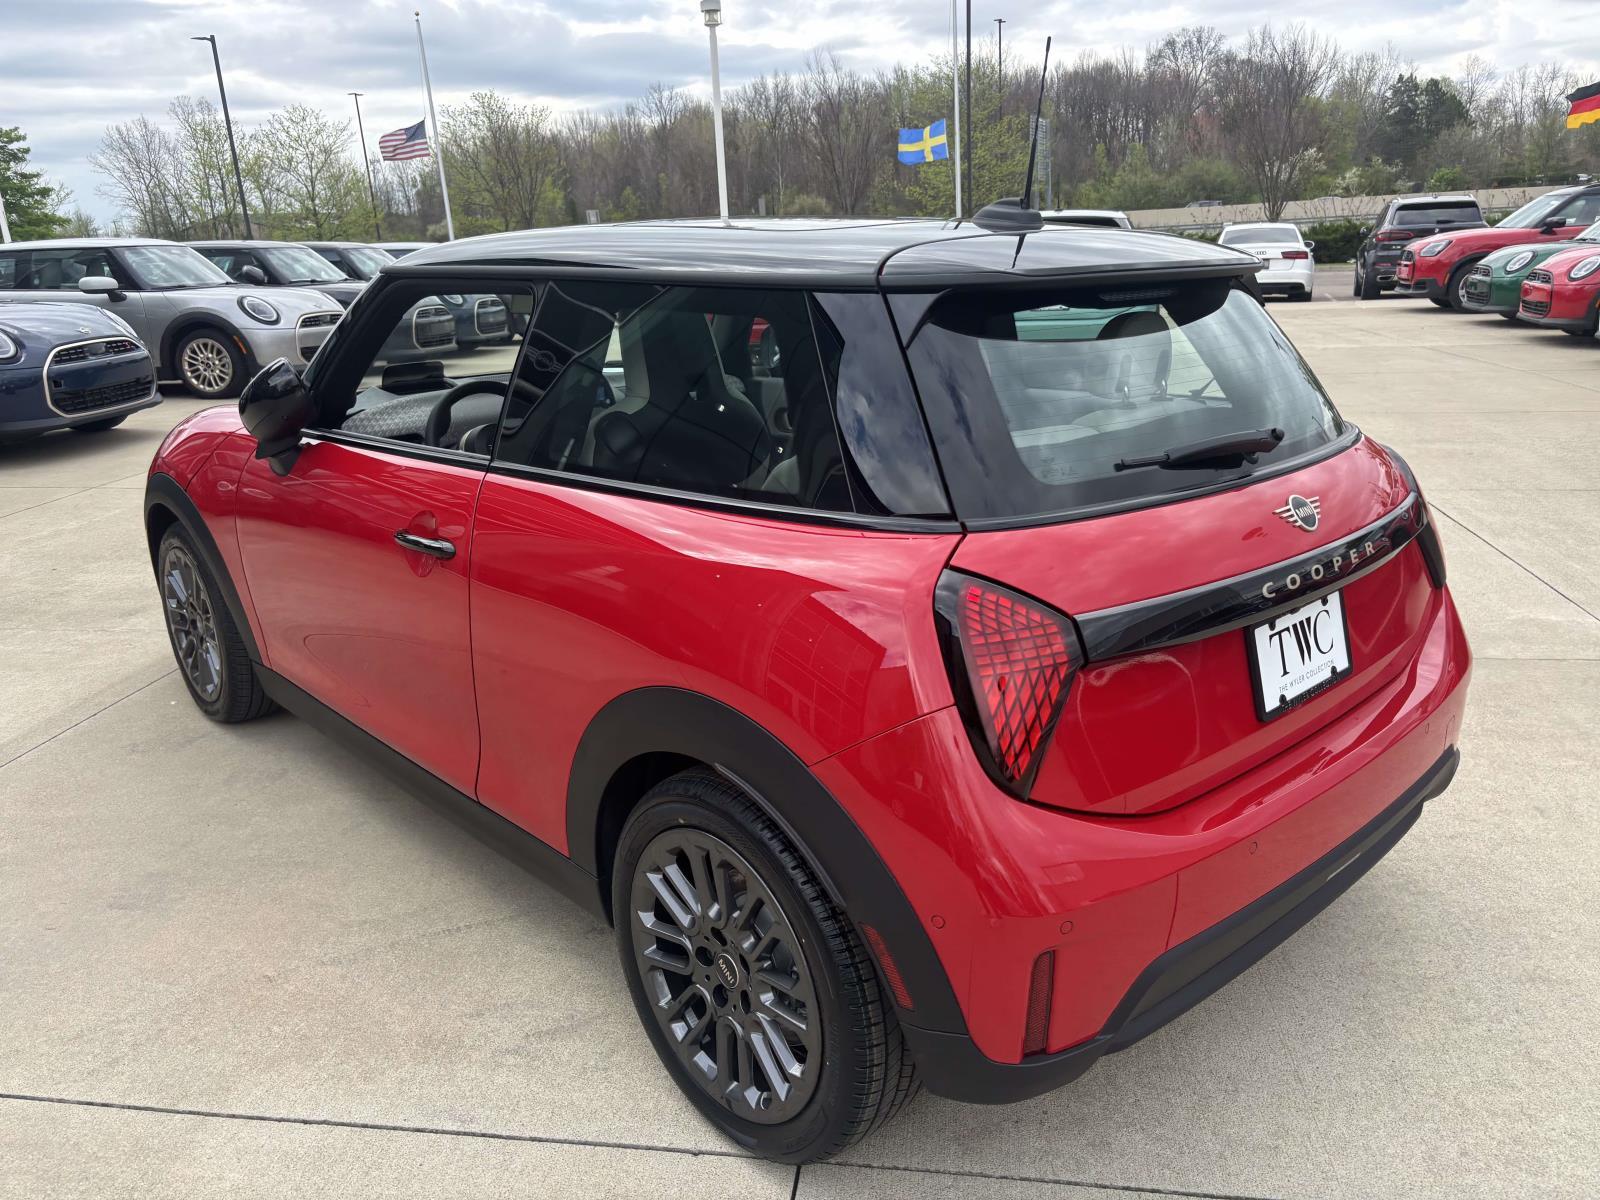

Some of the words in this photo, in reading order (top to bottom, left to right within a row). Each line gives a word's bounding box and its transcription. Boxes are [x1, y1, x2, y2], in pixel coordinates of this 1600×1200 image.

[1295, 505, 1314, 518] MINI
[1262, 541, 1375, 599] COOPER
[1268, 609, 1334, 678] TWC
[1279, 683, 1288, 693] THE
[1289, 675, 1305, 689] WYLER
[718, 958, 735, 984] MINI
